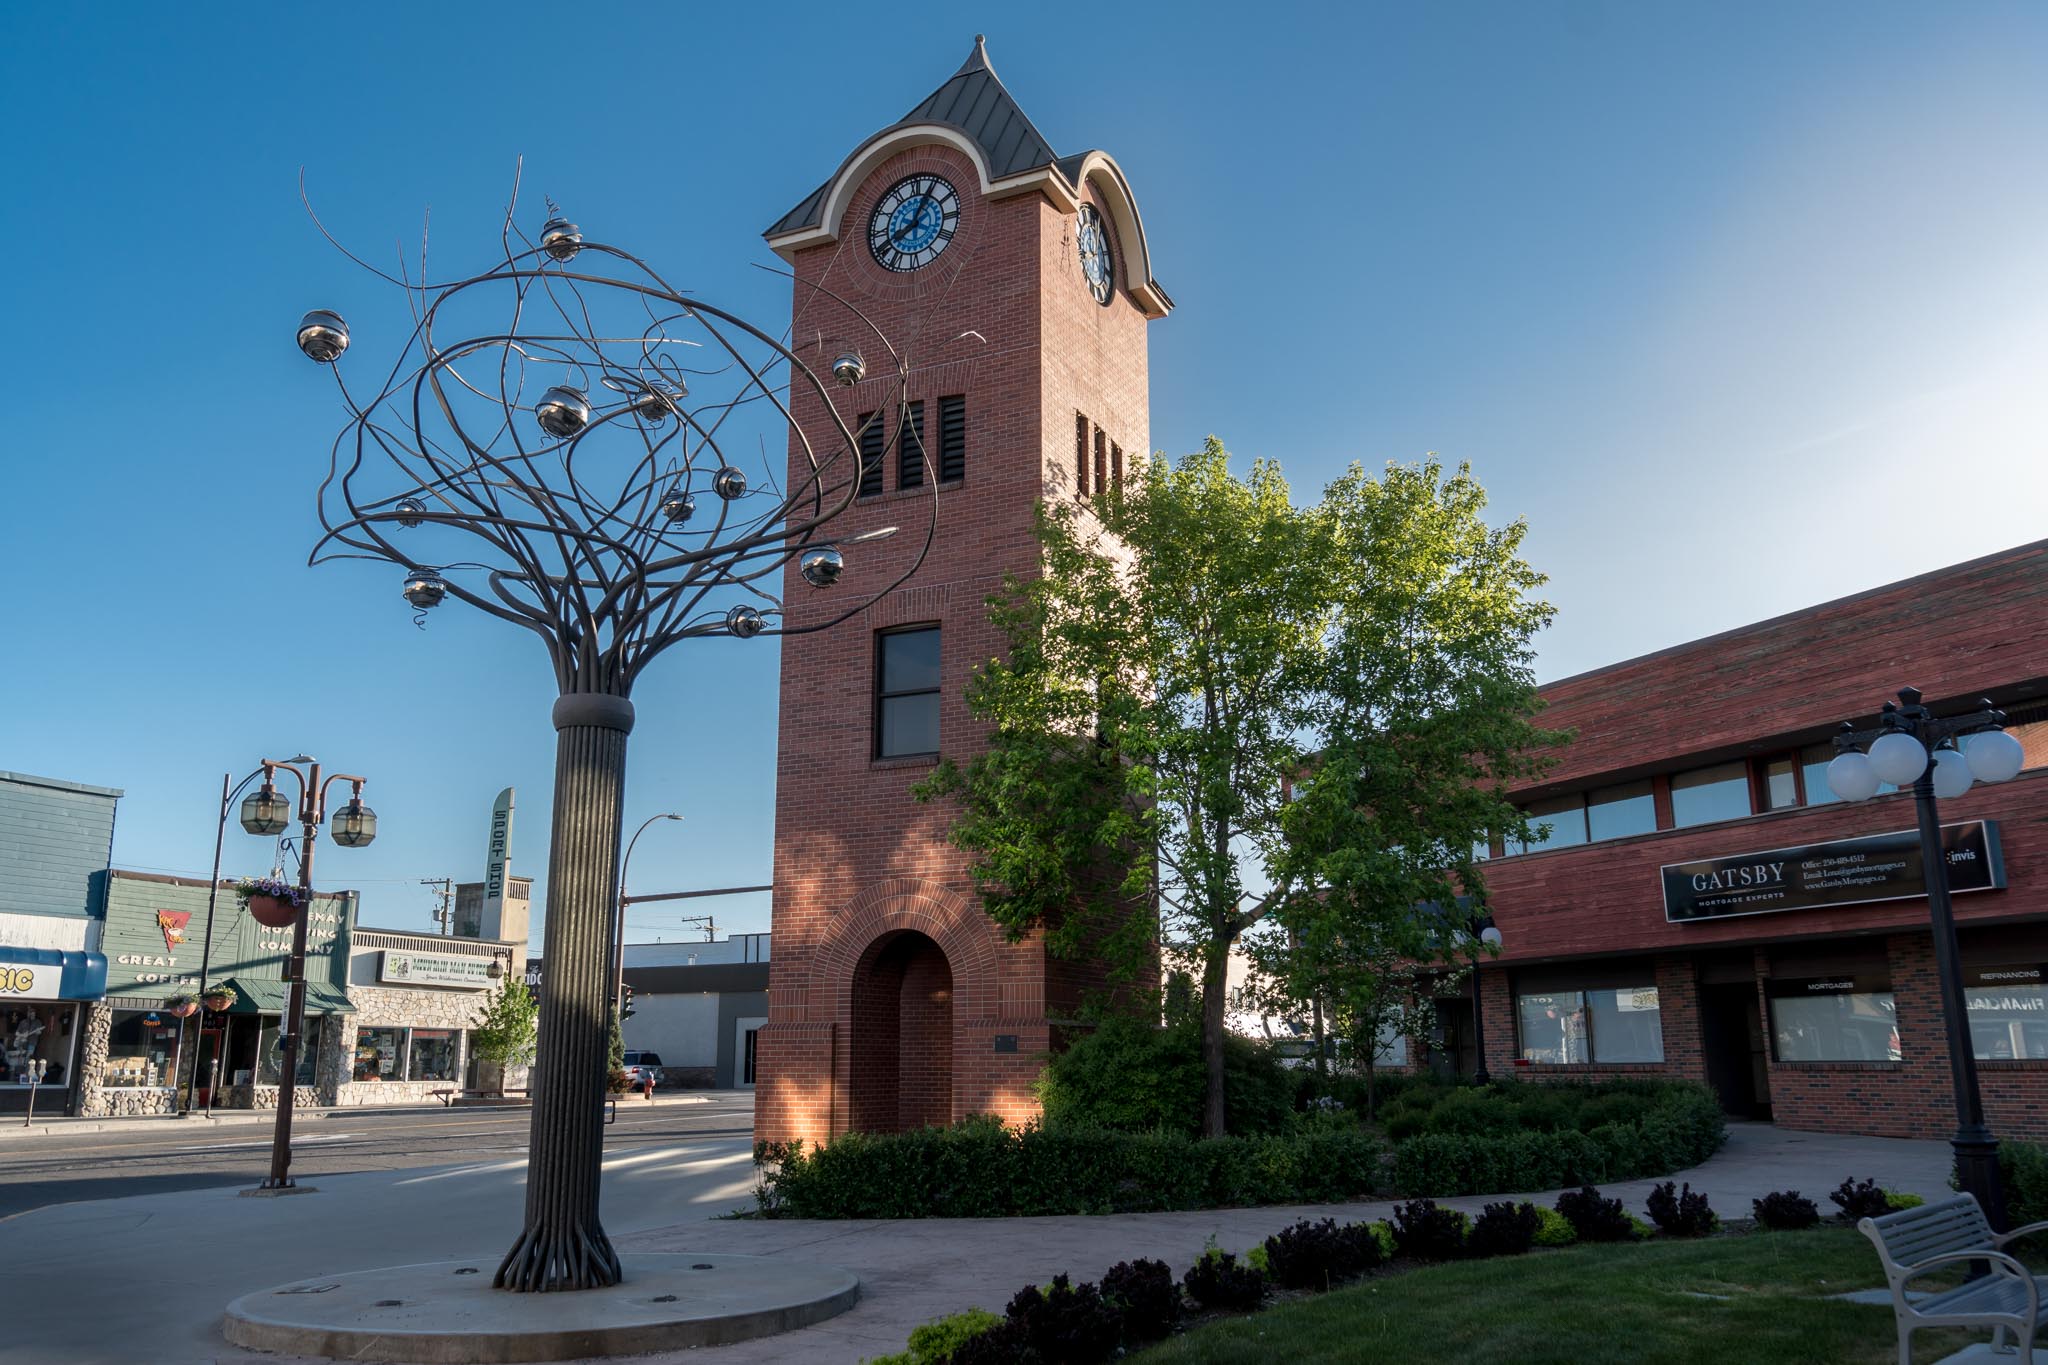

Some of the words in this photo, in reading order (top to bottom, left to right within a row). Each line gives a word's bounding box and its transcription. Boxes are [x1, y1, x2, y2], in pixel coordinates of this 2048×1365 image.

[492, 811, 506, 857] SPORT
[1951, 849, 1976, 862] invis
[488, 863, 502, 899] SHOP
[1692, 862, 1785, 891] GATSBY
[1698, 896, 1743, 907] MORTGAGE
[1746, 892, 1785, 902] EXPERTS
[261, 924, 337, 939] ROATING
[259, 941, 334, 954] COMANY
[117, 955, 178, 967] GREAT
[1980, 970, 2041, 980] REFINANCING
[1808, 982, 1854, 990] MORTGAGES
